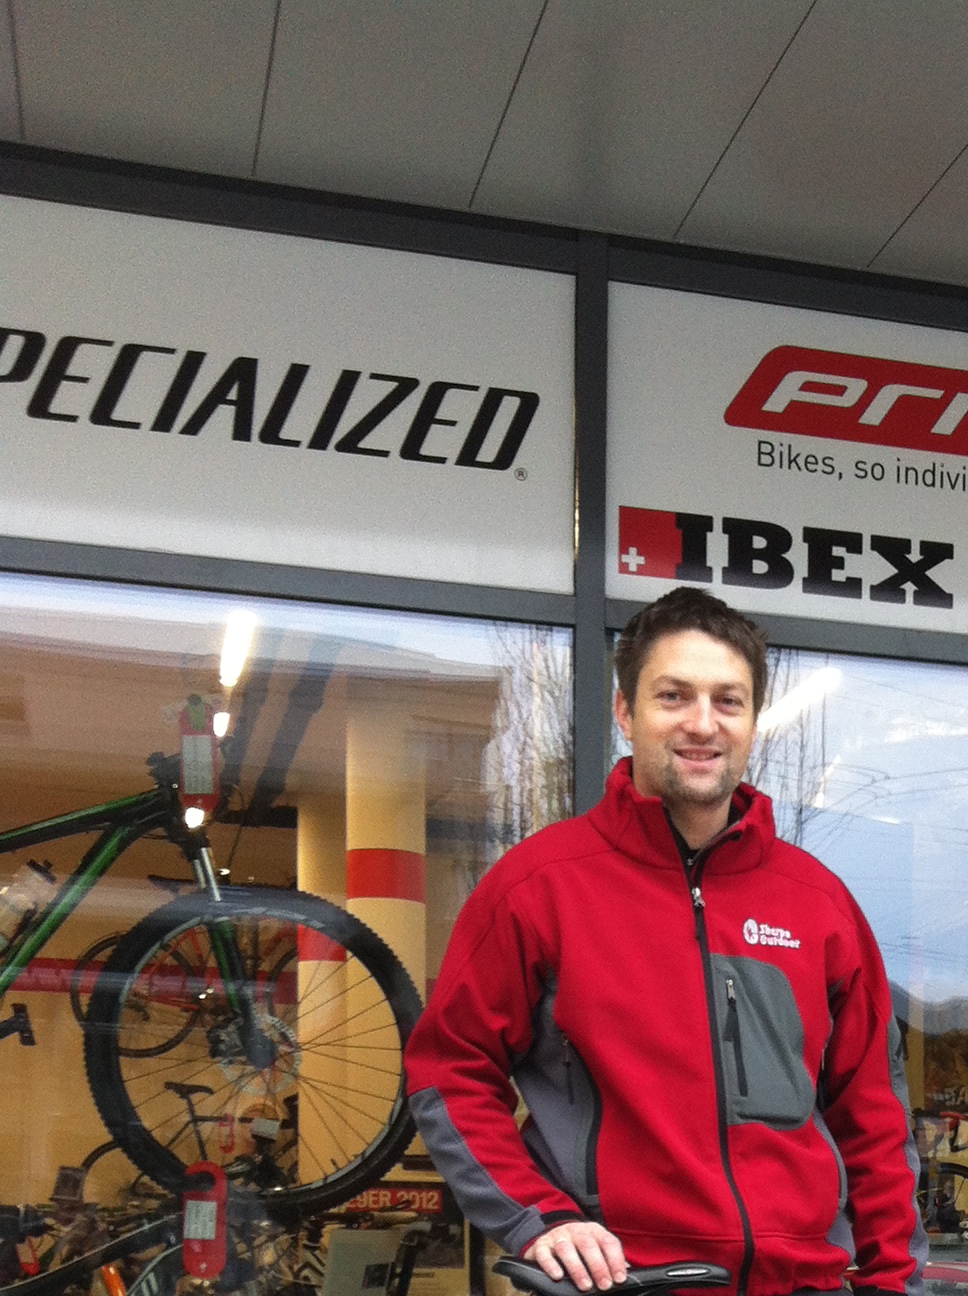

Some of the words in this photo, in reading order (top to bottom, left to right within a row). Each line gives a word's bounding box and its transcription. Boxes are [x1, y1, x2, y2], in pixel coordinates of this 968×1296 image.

[757, 442, 842, 481] Bikes,
[855, 461, 885, 482] so
[675, 513, 954, 609] IBEX
